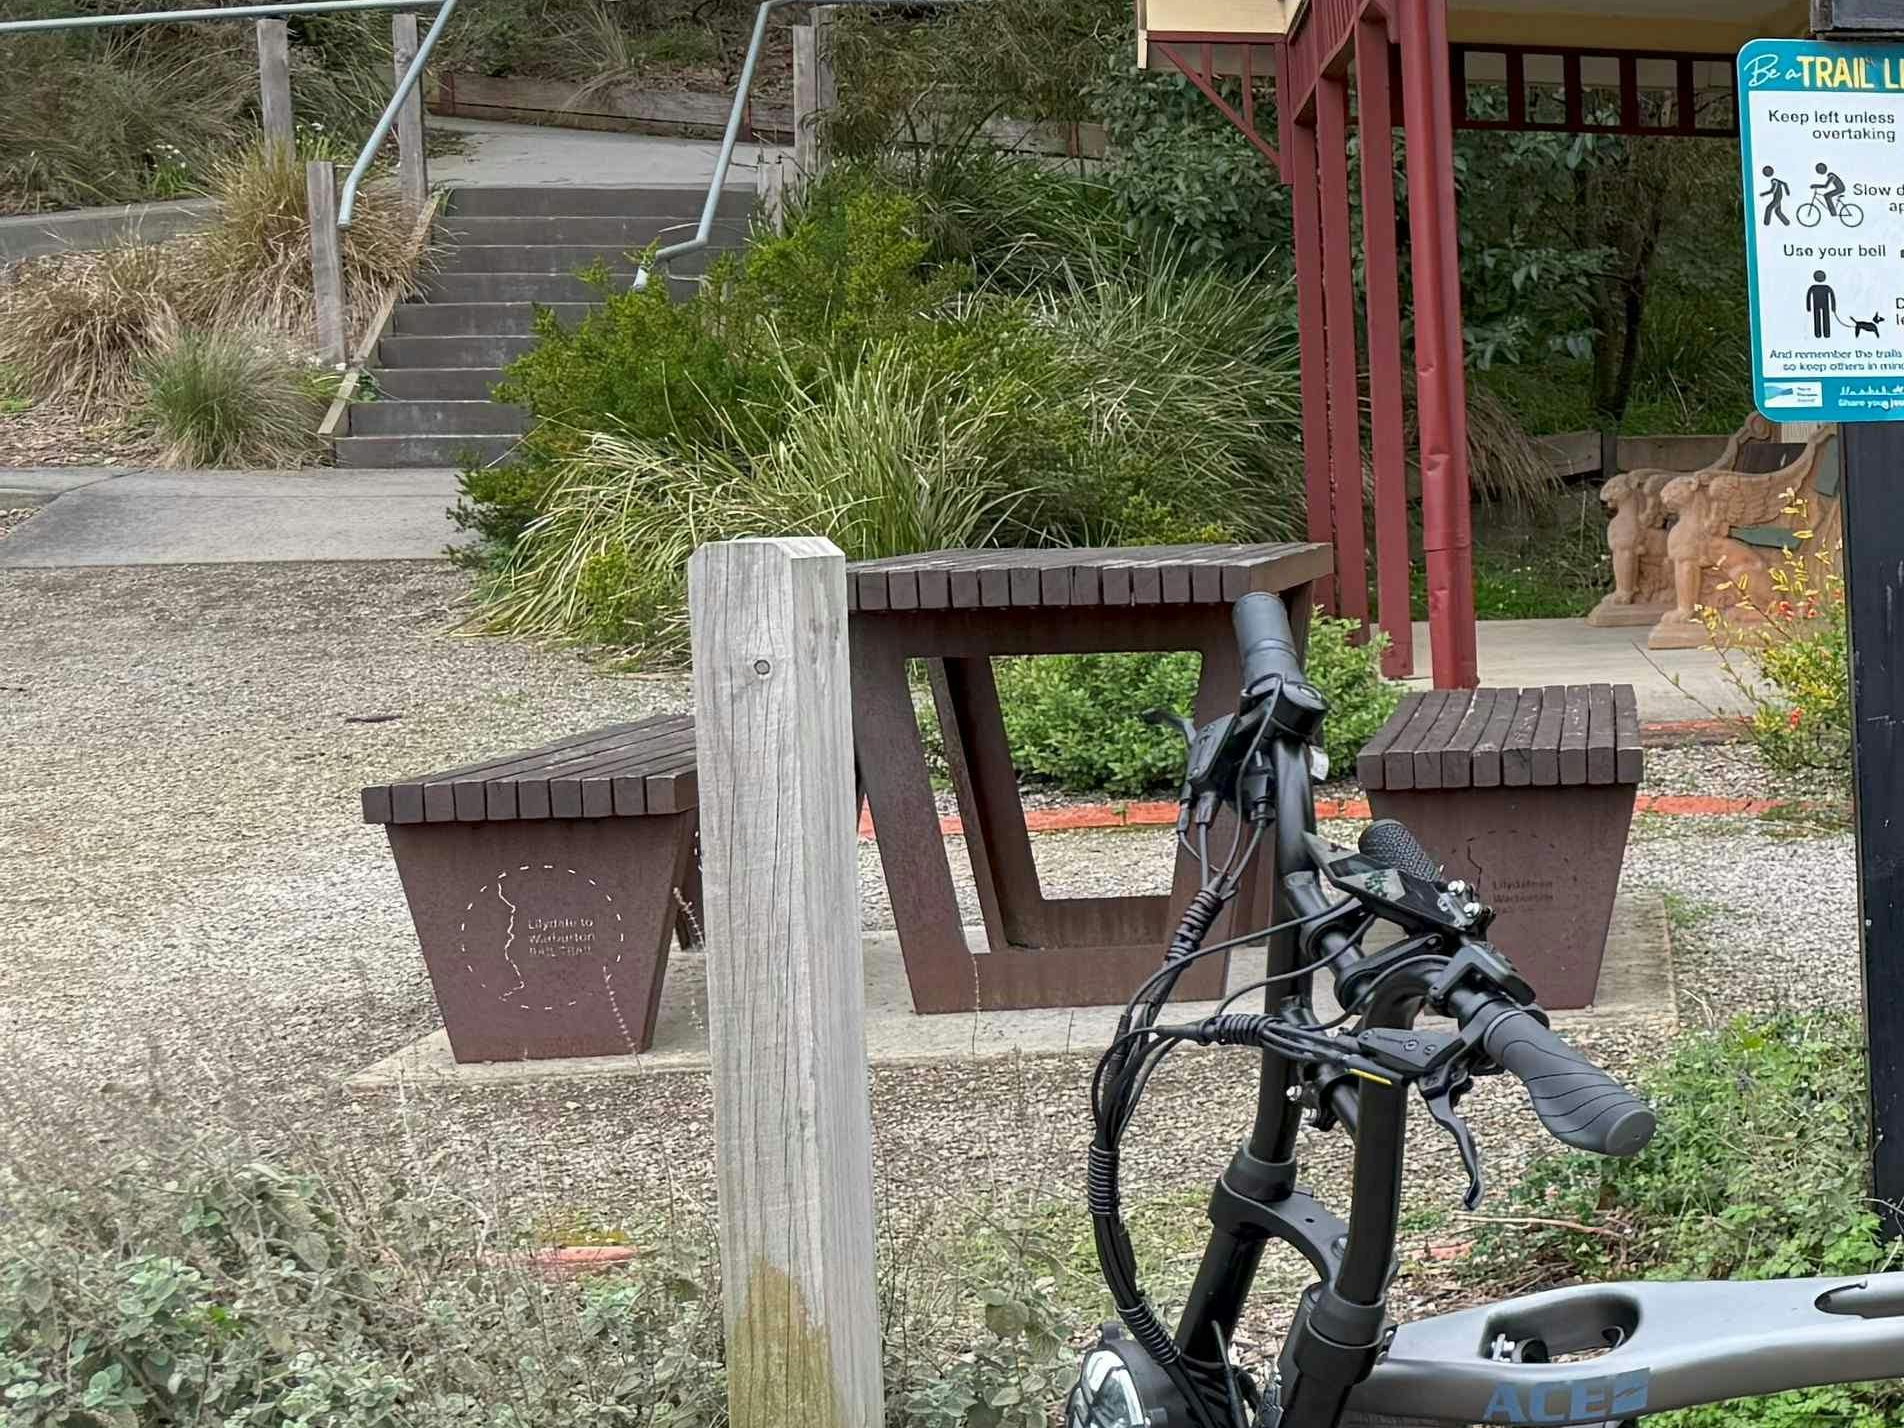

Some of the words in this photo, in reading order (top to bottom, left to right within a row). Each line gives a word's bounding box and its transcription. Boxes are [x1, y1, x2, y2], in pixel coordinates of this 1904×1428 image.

[1744, 54, 1780, 87] Be
[1797, 55, 1875, 88] TRAIL
[1768, 109, 1809, 126] Keep
[1814, 110, 1841, 123] left
[1845, 111, 1895, 123] unless
[1812, 128, 1896, 142] overtaking
[1852, 183, 1891, 197] Slow
[1783, 244, 1813, 257] Use
[1818, 246, 1853, 260] your
[1857, 244, 1886, 257] bell
[1770, 349, 1792, 359] And
[1795, 349, 1851, 359] remember
[1855, 349, 1872, 359] the
[1876, 349, 1902, 359] trails
[1783, 363, 1796, 372] so
[1800, 362, 1827, 373] keep
[1830, 362, 1865, 371] others
[1868, 362, 1878, 371] in
[1482, 1376, 1612, 1426] ACE
